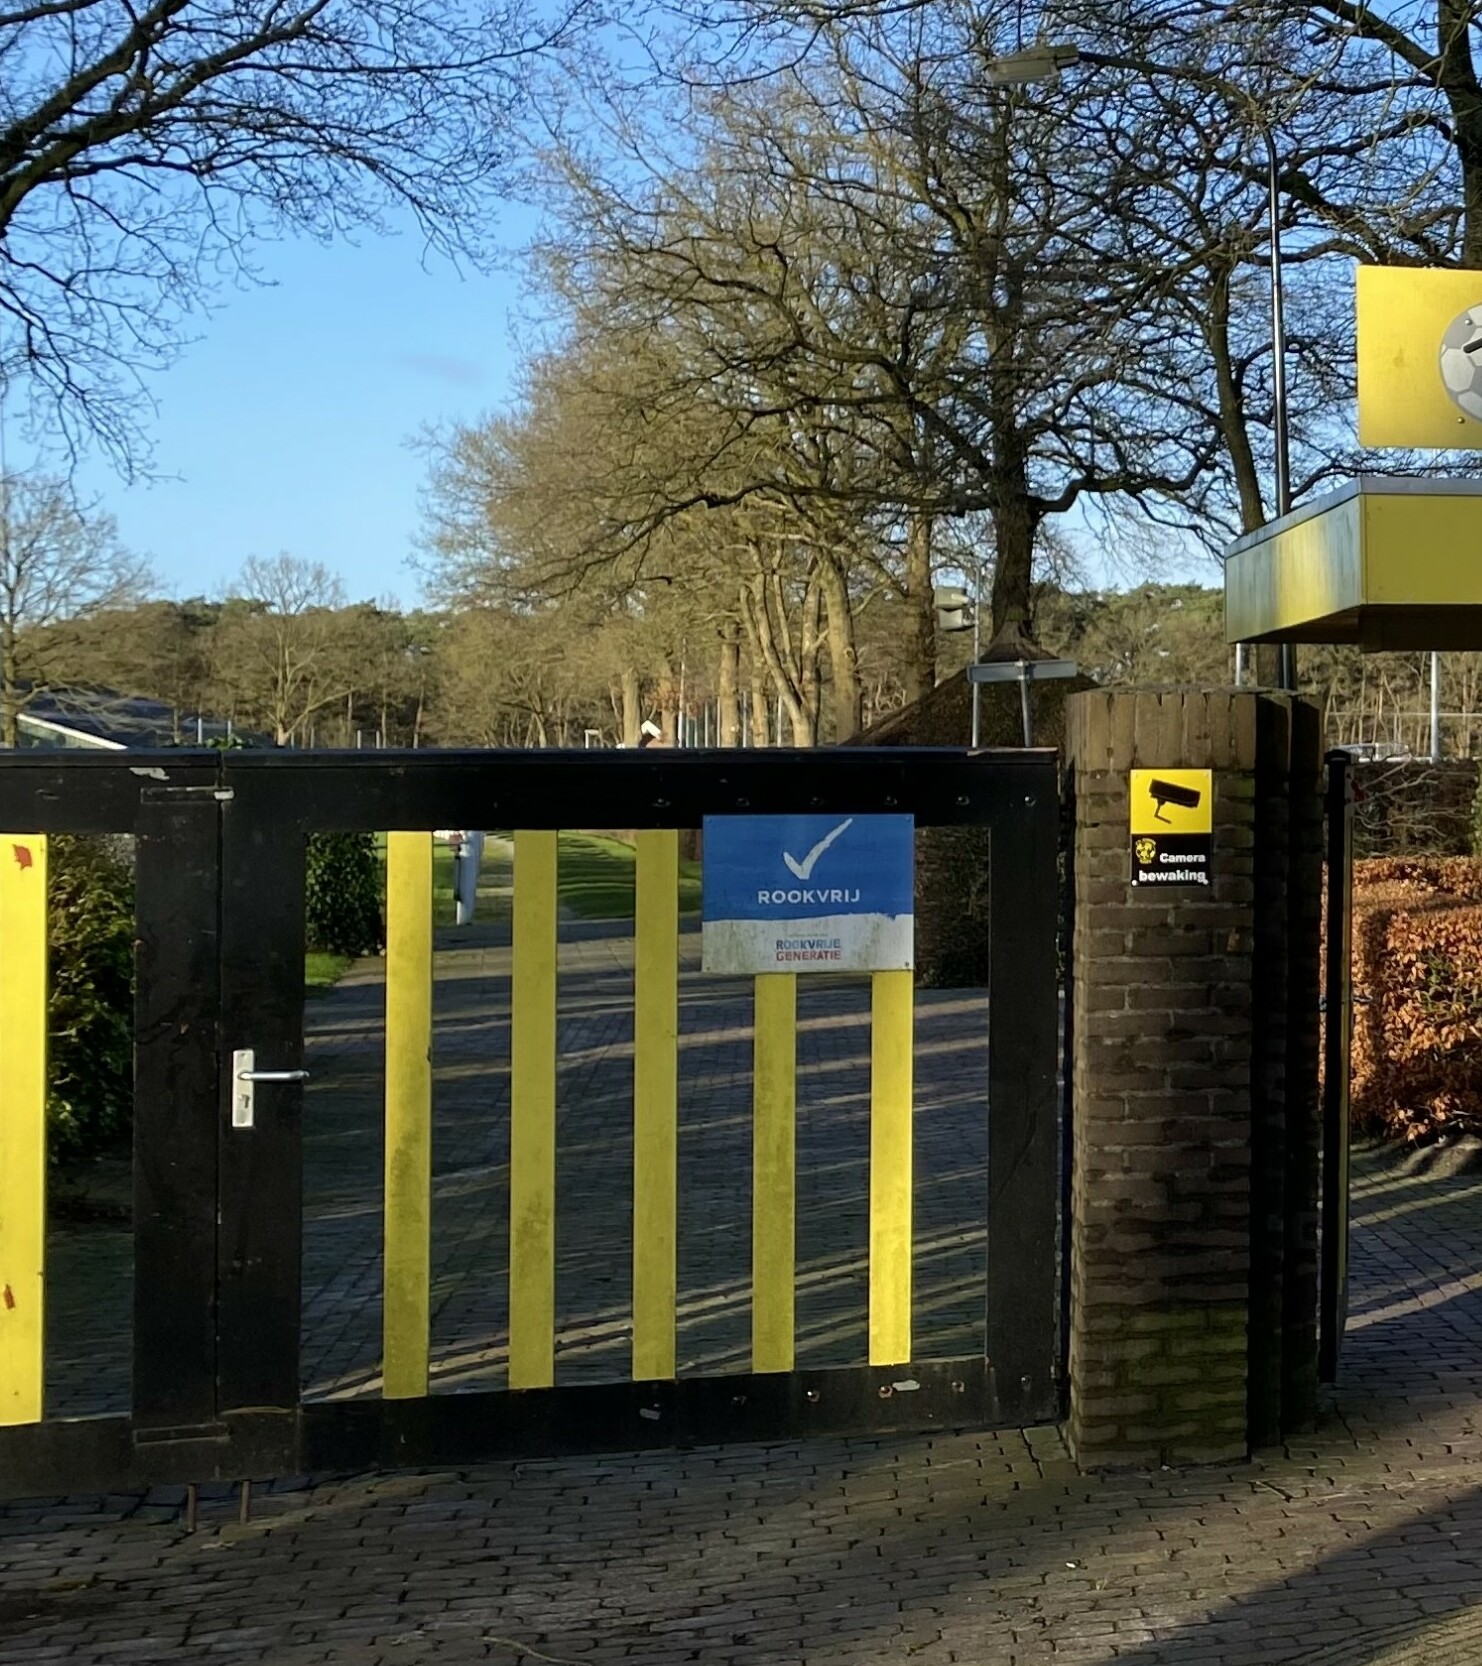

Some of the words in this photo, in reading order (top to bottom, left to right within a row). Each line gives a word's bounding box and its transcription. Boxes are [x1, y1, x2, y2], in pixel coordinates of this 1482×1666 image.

[1159, 852, 1206, 863] Camera
[1138, 869, 1207, 883] bewaking
[758, 889, 860, 904] ROOKVRIJ
[776, 939, 841, 950] ROOKVRIJE
[776, 950, 841, 961] GENERATIE
